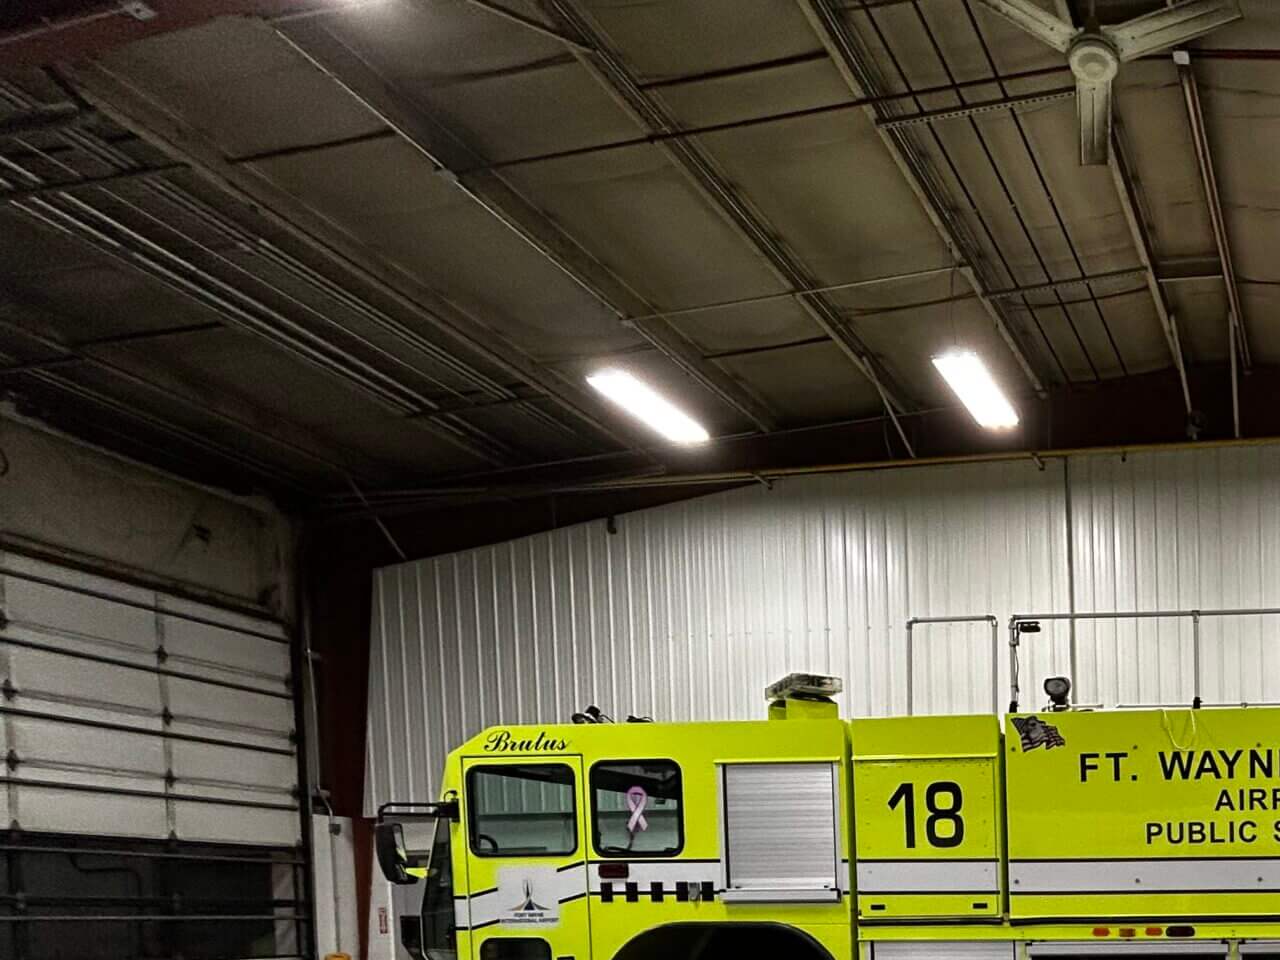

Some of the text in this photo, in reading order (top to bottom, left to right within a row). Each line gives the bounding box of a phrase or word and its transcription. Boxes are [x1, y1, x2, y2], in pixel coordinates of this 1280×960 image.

[484, 730, 570, 752] Brutus
[1079, 752, 1138, 782] FT.
[887, 781, 964, 849] 18
[1145, 820, 1258, 845] PUBLIC
